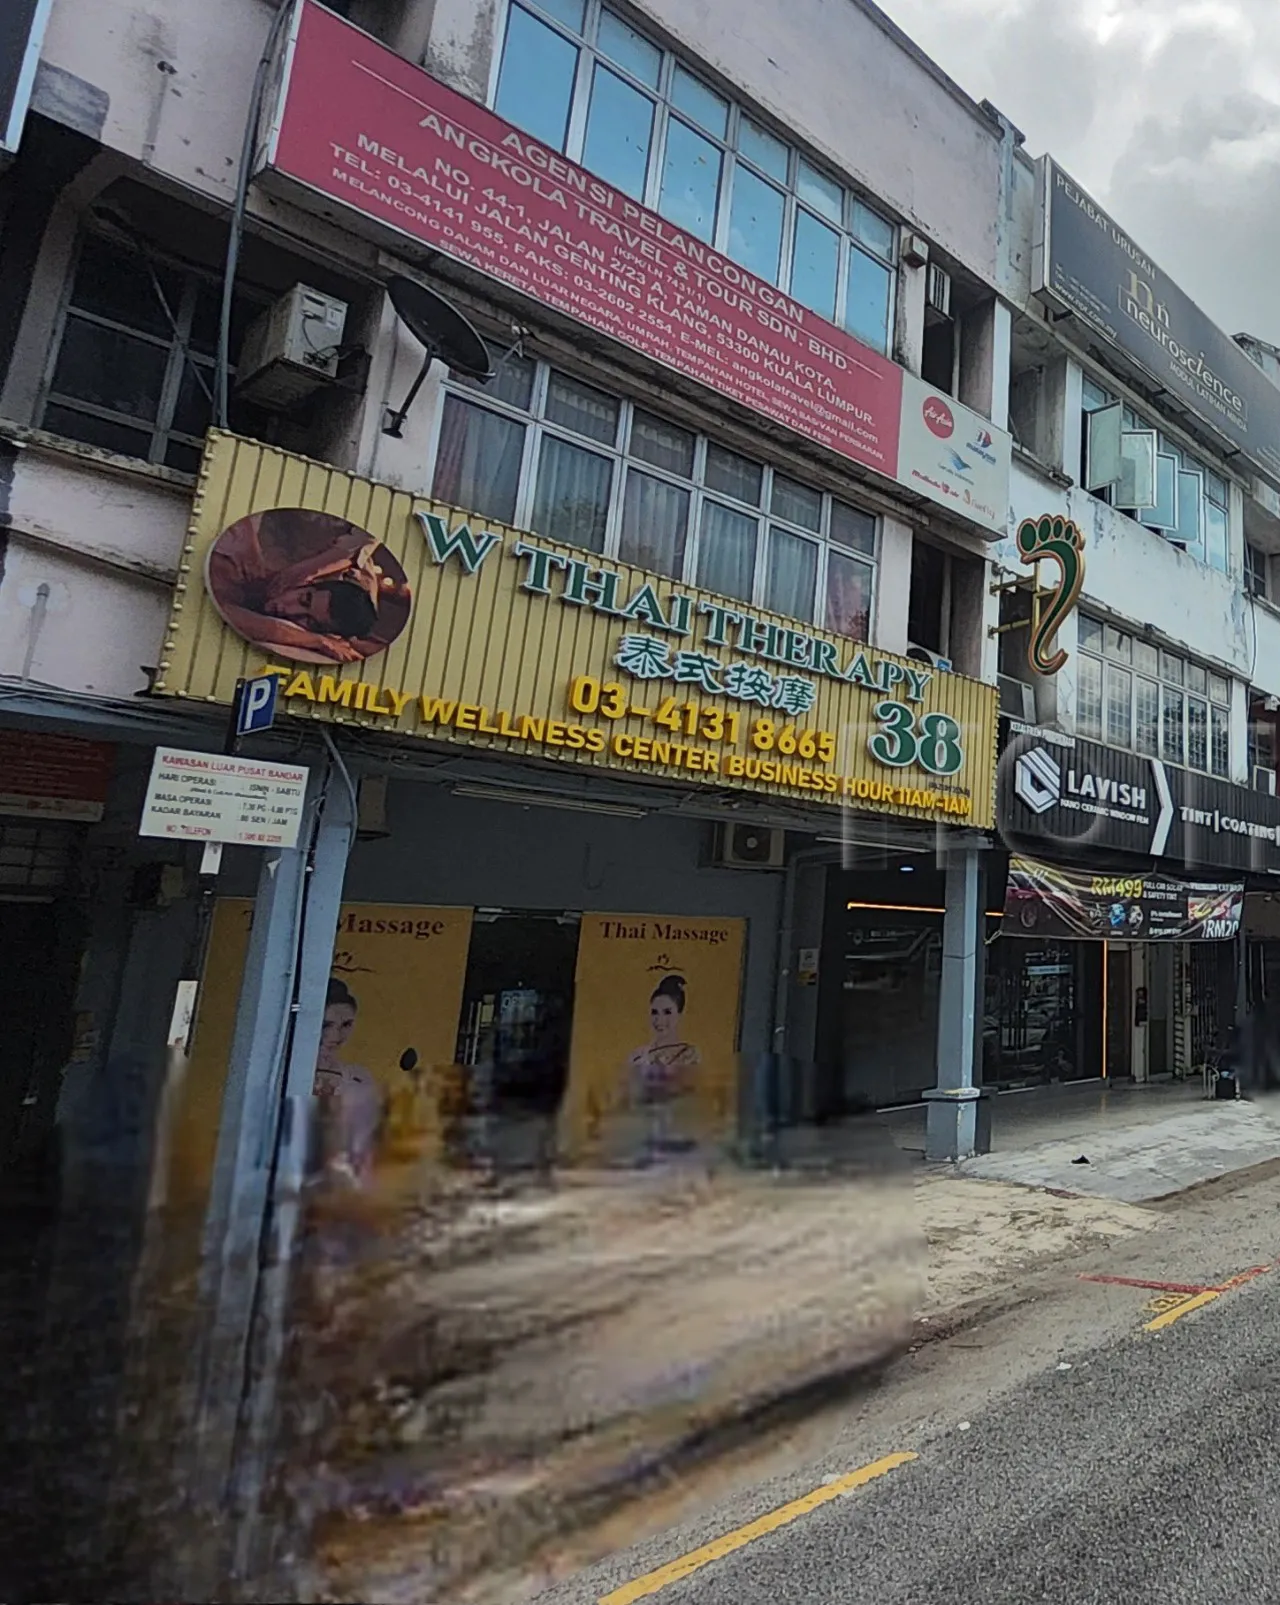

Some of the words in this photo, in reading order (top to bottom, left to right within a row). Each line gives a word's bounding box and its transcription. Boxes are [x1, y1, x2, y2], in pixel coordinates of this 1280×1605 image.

[356, 133, 469, 206] MELALUI
[474, 203, 548, 249] JALAN
[553, 243, 641, 299] GENTING
[716, 332, 759, 363] 53300
[763, 357, 814, 393] KUALA
[418, 113, 568, 211] ANGKOLA
[574, 199, 669, 269] TRAVEL
[672, 260, 690, 281] &
[692, 270, 754, 318] TOUR
[756, 308, 804, 347] SDN.
[808, 338, 853, 375] BHD.
[434, 157, 476, 191] NO.
[537, 219, 605, 262] JALAN
[609, 257, 647, 285] 2/23
[673, 291, 733, 335] TAMAN
[736, 327, 791, 366] DANAU
[501, 131, 615, 209] AGENSI
[622, 202, 804, 324] PELANCONGAN
[1056, 172, 1109, 233] PEJABAT
[1111, 226, 1157, 280] URUSAN
[329, 142, 382, 181] TEL:
[387, 176, 464, 225] 03-4141
[514, 242, 569, 281] FAKS:
[573, 275, 635, 315] 03-2602
[680, 333, 728, 365] E-MEL:
[731, 361, 878, 445] angkolatravel@gmail.com
[332, 167, 441, 230] MELANCONG
[443, 226, 496, 258] DALAM
[499, 255, 529, 277] DAN
[533, 272, 569, 297] LUAR
[675, 346, 734, 382] TEMPAHAN
[439, 239, 482, 267] SEWA
[543, 292, 615, 334] TEMPAHAN
[654, 347, 714, 385] TEMPAHAN
[1126, 297, 1243, 412] neuroscience
[415, 510, 502, 575] W
[512, 540, 696, 636] THAI
[699, 600, 933, 702] THERAPY
[244, 678, 271, 730] P
[616, 632, 817, 717] 泰式按摩
[419, 696, 606, 753] WELLNESS
[613, 732, 720, 774] CENTER
[726, 754, 838, 794] BUSINESS
[842, 776, 895, 804] HOUR
[898, 785, 972, 817] 11AM-1AM
[571, 675, 741, 747] 03-4131
[751, 718, 837, 764] 8665
[867, 699, 964, 776] 38
[151, 806, 181, 816] KADAR
[158, 773, 179, 782] HARI
[181, 775, 217, 786] OPERASI
[162, 755, 209, 769] KAWASAN
[211, 761, 235, 772] LUAR
[237, 766, 267, 777] PUSAT
[268, 770, 303, 781] BANDAR
[1060, 798, 1080, 809] NANO
[1067, 769, 1146, 809] LAVISH
[1179, 806, 1212, 826] TINT
[1221, 816, 1275, 840] COATING
[1091, 877, 1142, 898] RM499
[599, 921, 646, 939] Thai
[652, 922, 729, 945] Massage
